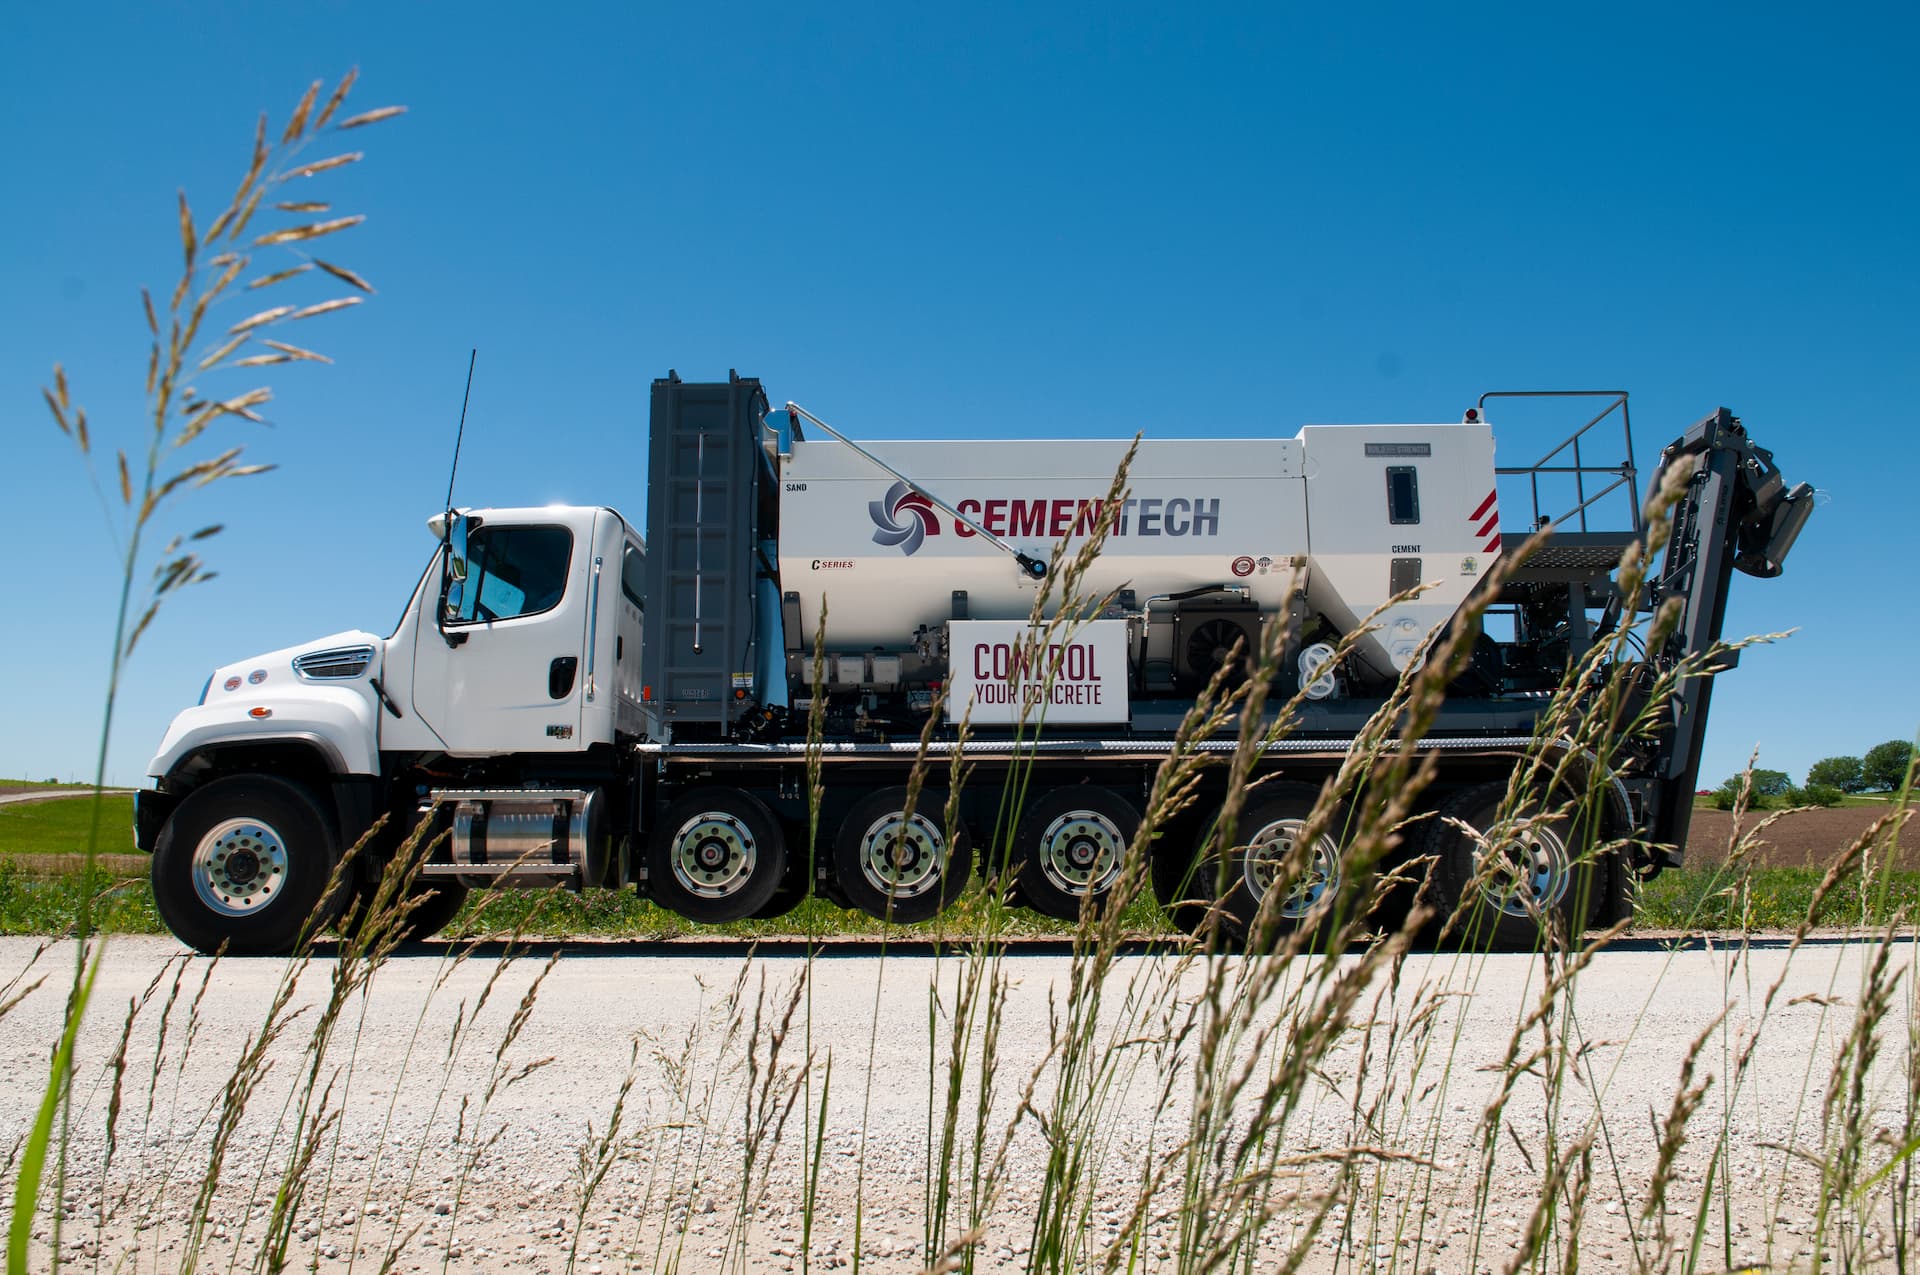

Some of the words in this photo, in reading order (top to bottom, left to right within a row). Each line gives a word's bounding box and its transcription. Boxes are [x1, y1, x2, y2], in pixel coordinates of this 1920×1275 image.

[954, 498, 1220, 538] CEMENTECH
[1392, 545, 1421, 553] CEMENT
[811, 559, 820, 571] C
[821, 561, 854, 569] SERIES
[975, 683, 1017, 704] YOUR
